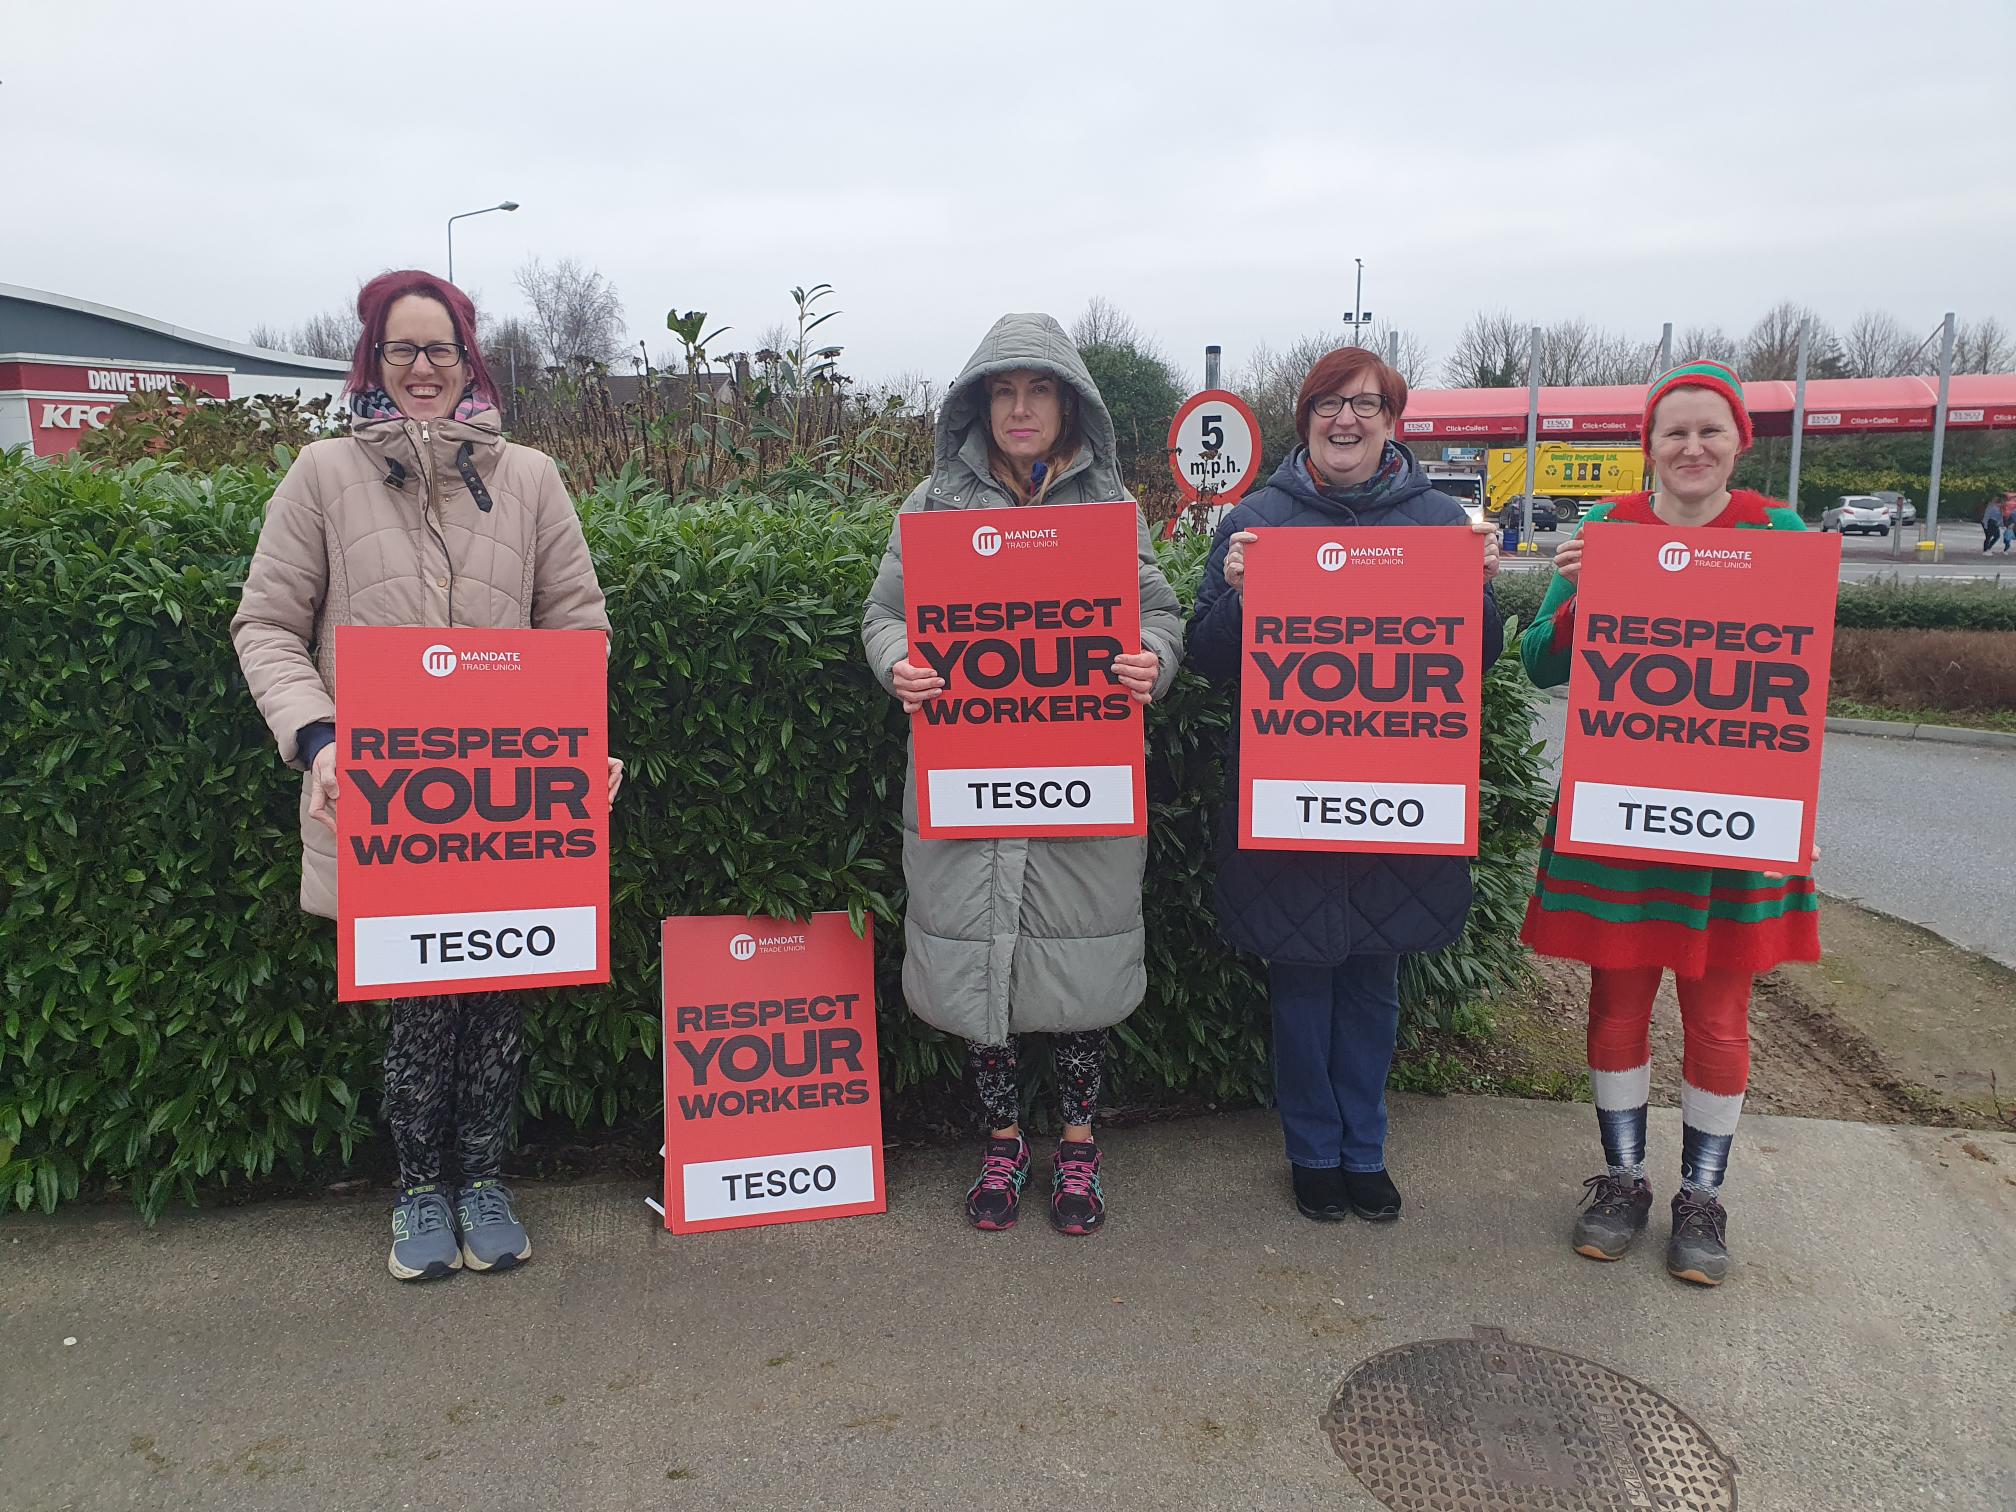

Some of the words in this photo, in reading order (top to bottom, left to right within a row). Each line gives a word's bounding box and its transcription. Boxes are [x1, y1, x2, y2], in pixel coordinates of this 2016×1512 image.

[88, 370, 137, 392] DRIVE
[40, 404, 111, 430] KFC
[1201, 415, 1224, 451] 5
[1190, 455, 1241, 478] m.p.h.
[1005, 529, 1057, 539] MANDATE
[1006, 541, 1031, 549] TRADE
[1033, 540, 1058, 548] UNION
[1350, 547, 1404, 557] MANDATE
[1694, 549, 1752, 560] MANDATE
[1694, 560, 1722, 568] TRADE
[1724, 561, 1752, 569] UNION
[917, 598, 1121, 634] RESPECT
[1255, 616, 1464, 645] RESPECT
[1587, 613, 1814, 656] RESPECT
[460, 651, 520, 662] MANDATE
[462, 663, 490, 671] TRADE
[492, 663, 521, 671] UNION
[913, 636, 1124, 690] YOUR
[1249, 651, 1464, 704] YOUR
[1580, 649, 1810, 716] YOUR
[921, 693, 1131, 725] WORKERS
[1251, 708, 1468, 739] WORKERS
[351, 726, 588, 760] RESPECT
[1578, 708, 1811, 753] WORKERS
[345, 766, 591, 825] YOUR
[968, 780, 1091, 809] TESCO
[1296, 795, 1424, 827] TESCO
[1618, 801, 1756, 841] TESCO
[350, 828, 596, 865] WORKERS
[411, 925, 555, 964] TESCO
[759, 936, 805, 945] MANDATE
[677, 994, 859, 1033] RESPECT
[673, 1028, 864, 1086] YOUR
[678, 1079, 869, 1120] WORKERS
[722, 1164, 836, 1201] TESCO
